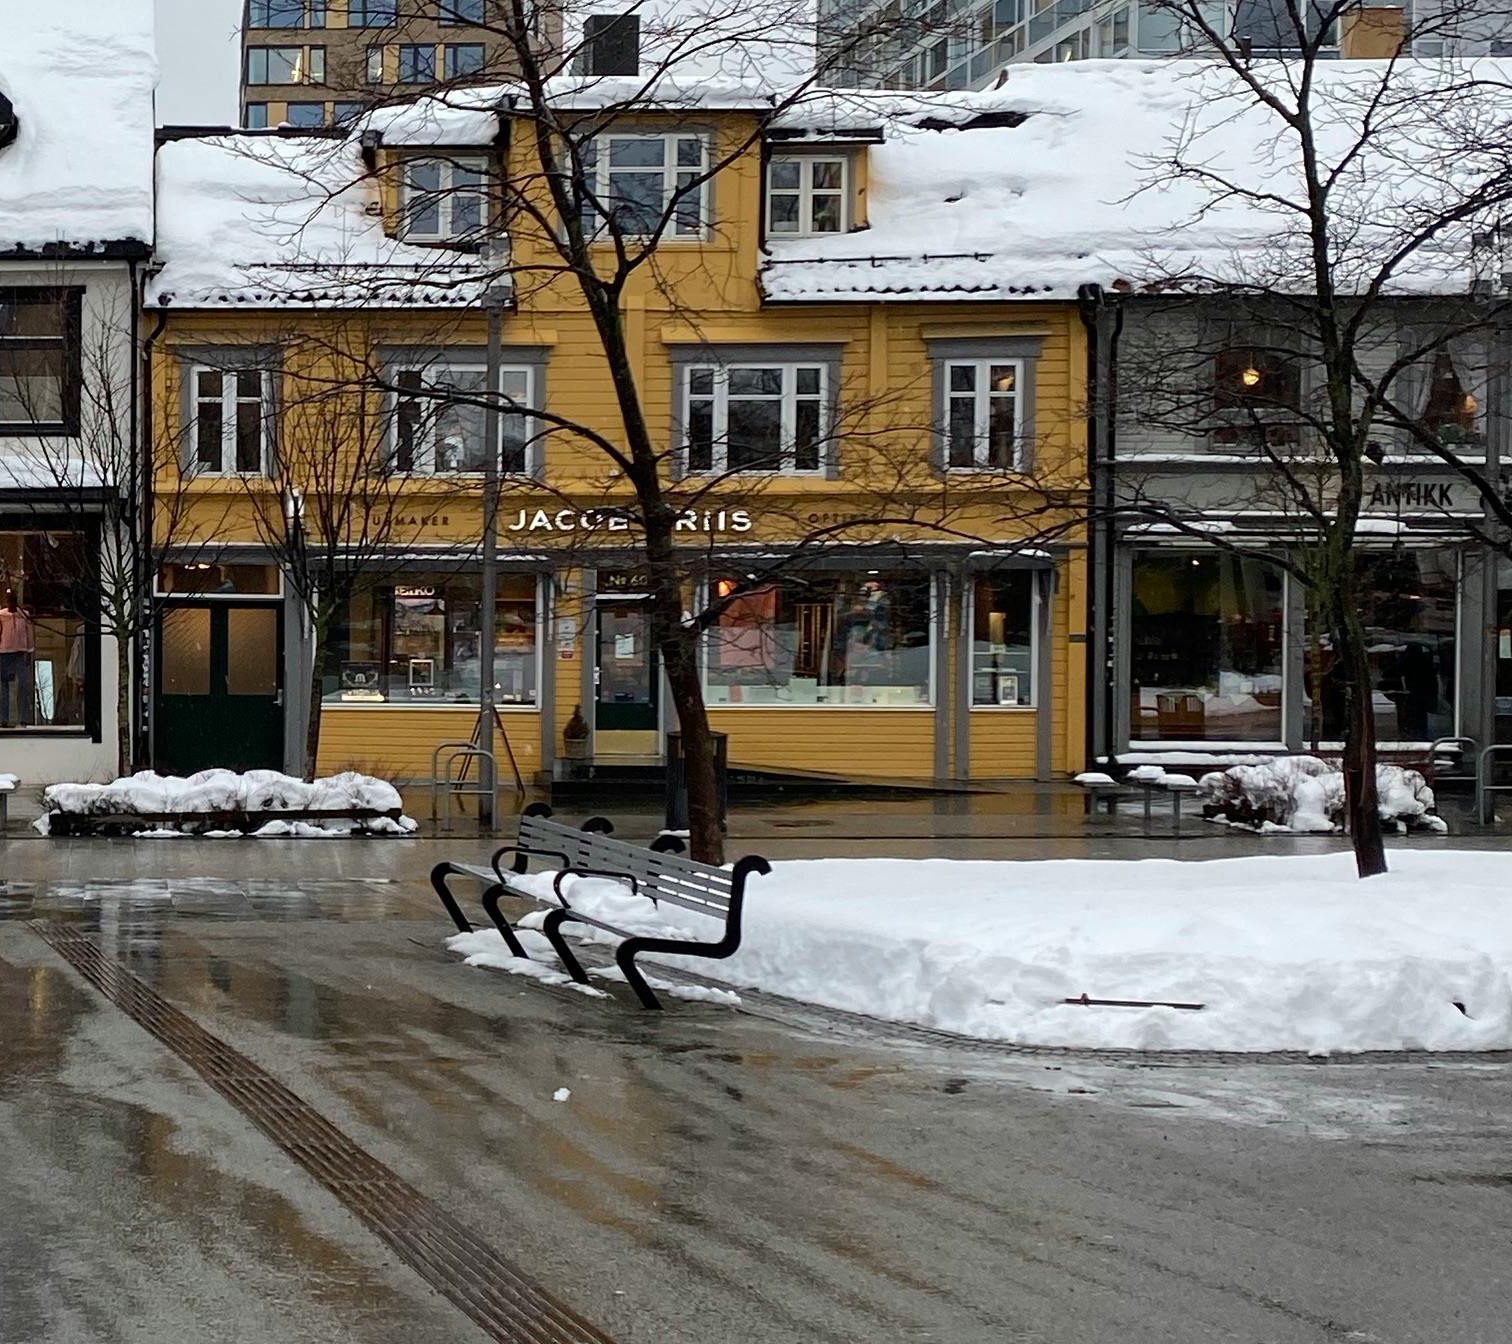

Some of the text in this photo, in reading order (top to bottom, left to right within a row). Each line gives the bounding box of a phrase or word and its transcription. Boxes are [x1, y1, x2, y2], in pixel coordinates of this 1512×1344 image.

[1369, 483, 1454, 507] ANTIKK
[372, 516, 450, 526] UMAKER
[675, 509, 752, 531] RIIS
